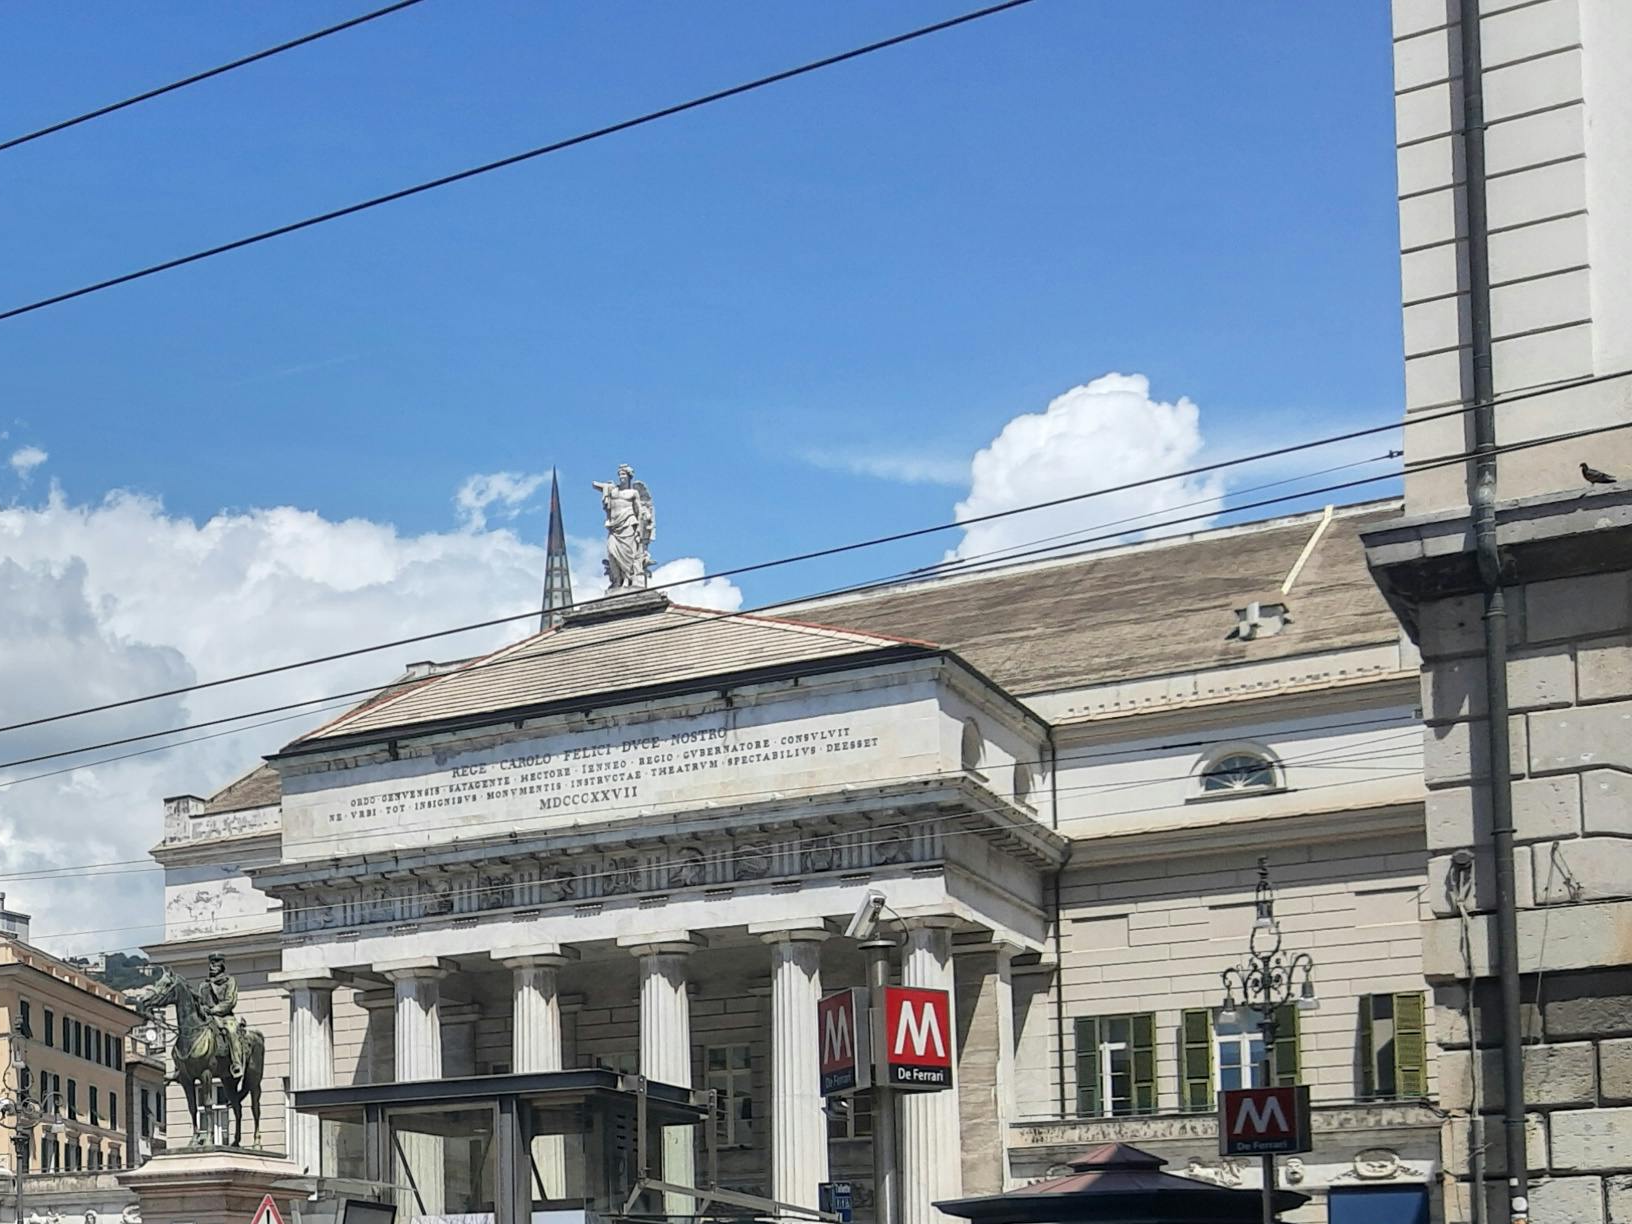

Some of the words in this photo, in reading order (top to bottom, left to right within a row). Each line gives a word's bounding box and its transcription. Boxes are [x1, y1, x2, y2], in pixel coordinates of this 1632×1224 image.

[350, 796, 376, 808] ORDO
[520, 767, 571, 783] HECTORE
[639, 753, 673, 766] REGIO
[683, 740, 770, 760] GVBERNATORE
[781, 728, 850, 745] CONSVLVIT
[500, 752, 552, 770] CAROLO
[563, 743, 612, 762] FELICI
[622, 736, 661, 753] DVCE
[671, 727, 727, 746] NOSTRO
[329, 813, 342, 823] NE
[350, 808, 376, 820] VRBI
[386, 804, 405, 814] TOT
[414, 794, 477, 811] INSIGNIBVS
[486, 782, 561, 800] MONVMENTIS
[570, 771, 642, 788] INSTRVCTAE
[651, 759, 718, 777] THEATRVM
[727, 746, 816, 767] SPECTABILIVS
[826, 737, 879, 753] DEESSET
[539, 786, 639, 811] MDCCCXXVII
[824, 1005, 852, 1065] M
[894, 1000, 946, 1058] M
[898, 1067, 911, 1080] De
[913, 1068, 944, 1082] Ferrari
[1232, 1096, 1289, 1135] M
[1236, 1142, 1251, 1151] De
[1253, 1140, 1288, 1150] Ferrari
